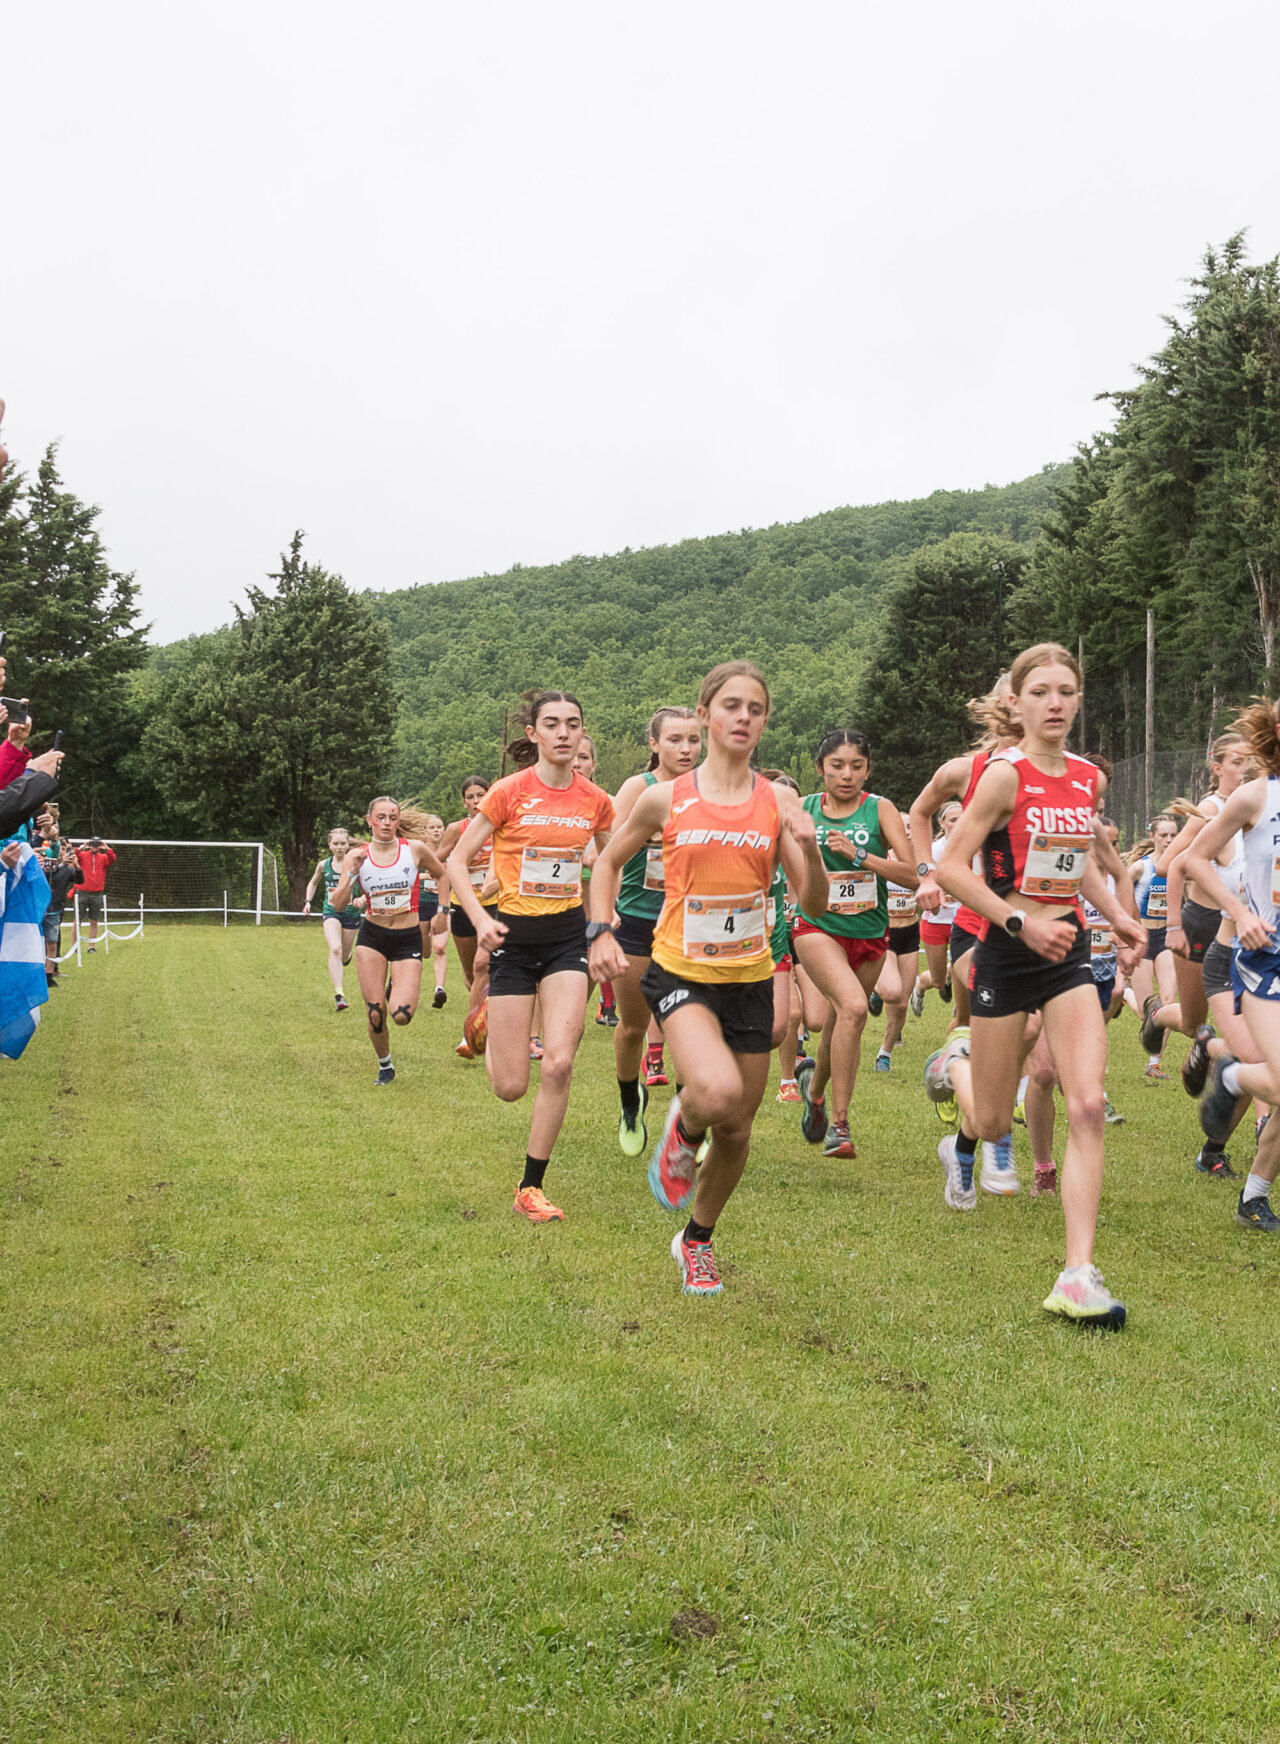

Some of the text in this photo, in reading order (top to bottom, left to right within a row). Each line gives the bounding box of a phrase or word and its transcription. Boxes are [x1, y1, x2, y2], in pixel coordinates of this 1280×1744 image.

[520, 814, 591, 830] ESPAÑA
[676, 829, 771, 851] ESPAÑA
[1055, 853, 1075, 872] 49
[551, 863, 561, 878] 2
[839, 884, 855, 898] 28
[385, 896, 396, 905] 58
[896, 899, 906, 907] 59
[724, 915, 735, 934] 4
[1091, 932, 1102, 942] 15
[659, 989, 689, 1013] ESP
